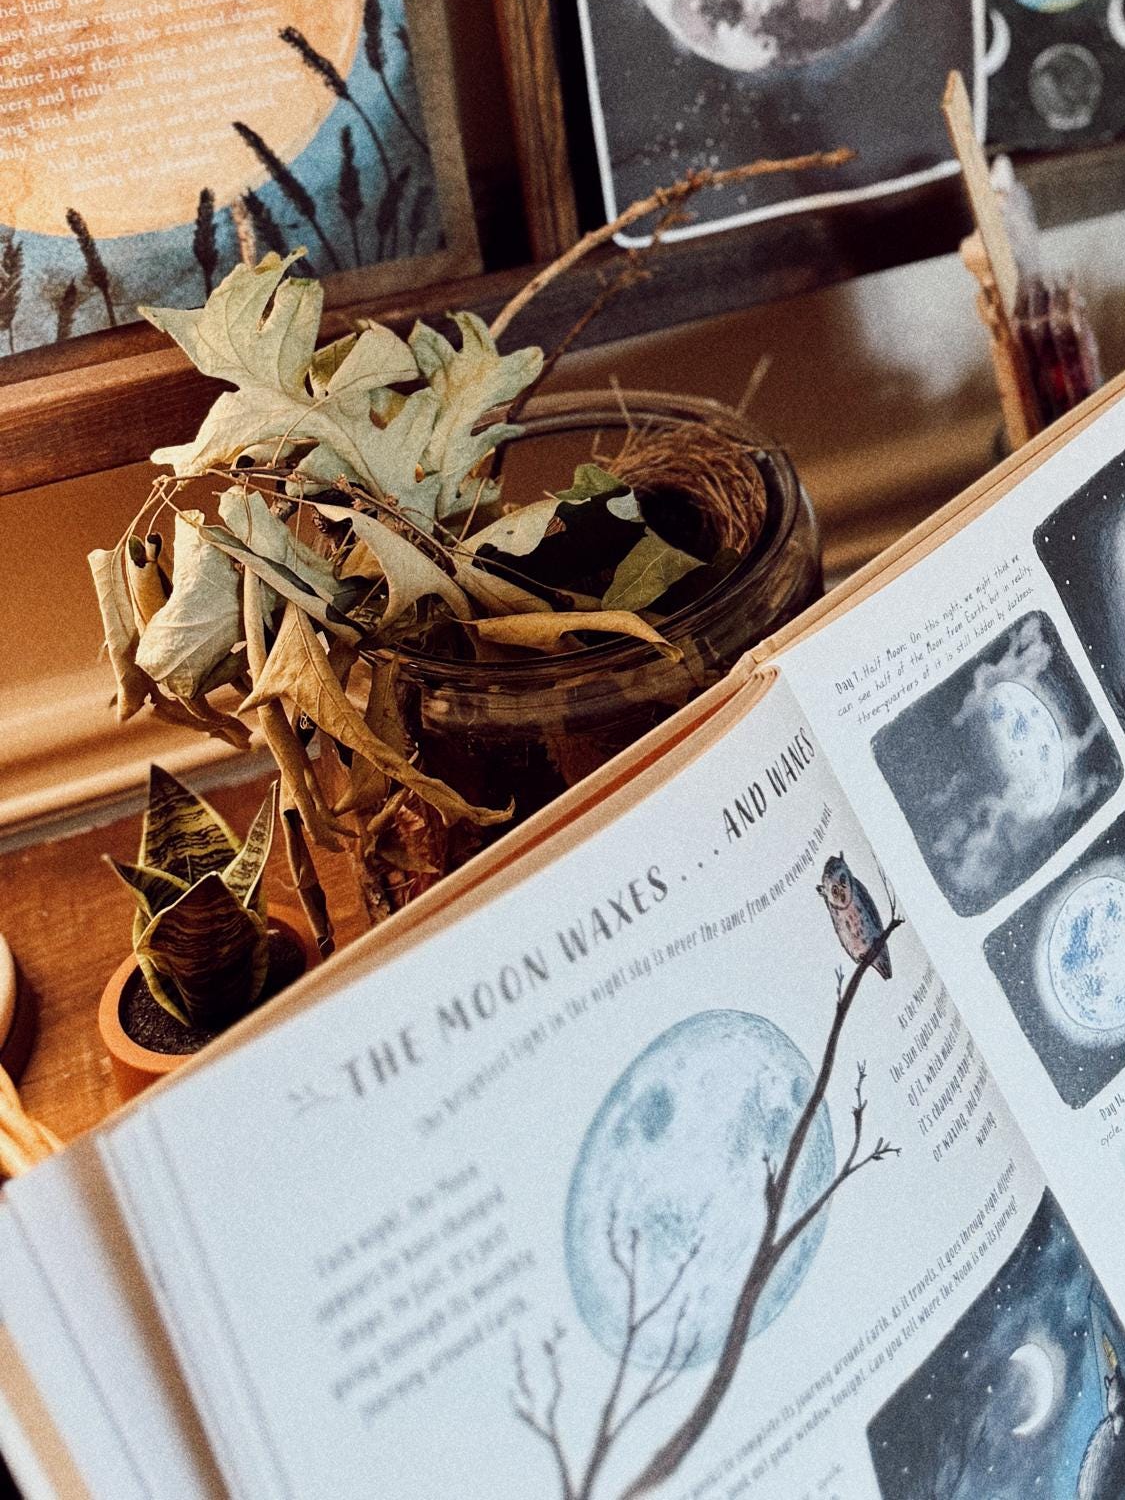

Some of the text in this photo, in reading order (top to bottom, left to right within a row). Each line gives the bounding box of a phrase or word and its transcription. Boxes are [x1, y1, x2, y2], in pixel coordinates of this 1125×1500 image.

[49, 64, 86, 81] have
[37, 87, 66, 106] and
[834, 676, 855, 695] Day
[862, 656, 881, 678] Half
[909, 631, 921, 644] On
[924, 618, 940, 633] this
[838, 701, 854, 717] can
[858, 689, 872, 704] see
[875, 669, 892, 691] half
[897, 660, 905, 677] of
[911, 651, 924, 666] the
[926, 636, 944, 654] Moon
[945, 621, 963, 639] from
[856, 678, 919, 725] three-quarters
[923, 663, 930, 680] of
[935, 658, 942, 670] it
[945, 651, 954, 662] is
[957, 632, 972, 654] still
[973, 618, 996, 639] hidden
[807, 838, 820, 856] to
[812, 825, 826, 845] the
[784, 848, 815, 886] evening
[769, 881, 786, 902] one
[341, 726, 815, 1098] THE MOON WAXES AND WANES
[720, 908, 748, 937] same
[746, 894, 771, 924] from
[665, 928, 699, 961] never
[699, 917, 720, 944] the
[629, 952, 652, 983] sky
[652, 941, 666, 967] is
[897, 1000, 918, 1030] As the
[902, 1045, 919, 1069] Sun
[913, 1020, 934, 1053] lights
[907, 1052, 944, 1107] of which
[917, 1074, 962, 1136] it's changing
[1099, 1102, 1118, 1121] Day
[932, 1143, 943, 1163] or
[965, 1090, 978, 1117] and
[936, 1256, 947, 1273] it
[945, 1239, 963, 1267] goes
[960, 1206, 986, 1246] through
[984, 1188, 1001, 1216] eight
[917, 1294, 942, 1325] where
[939, 1284, 955, 1301] the
[952, 1260, 975, 1288] Moon
[970, 1251, 980, 1266] is
[978, 1240, 989, 1257] on
[985, 1228, 998, 1246] its
